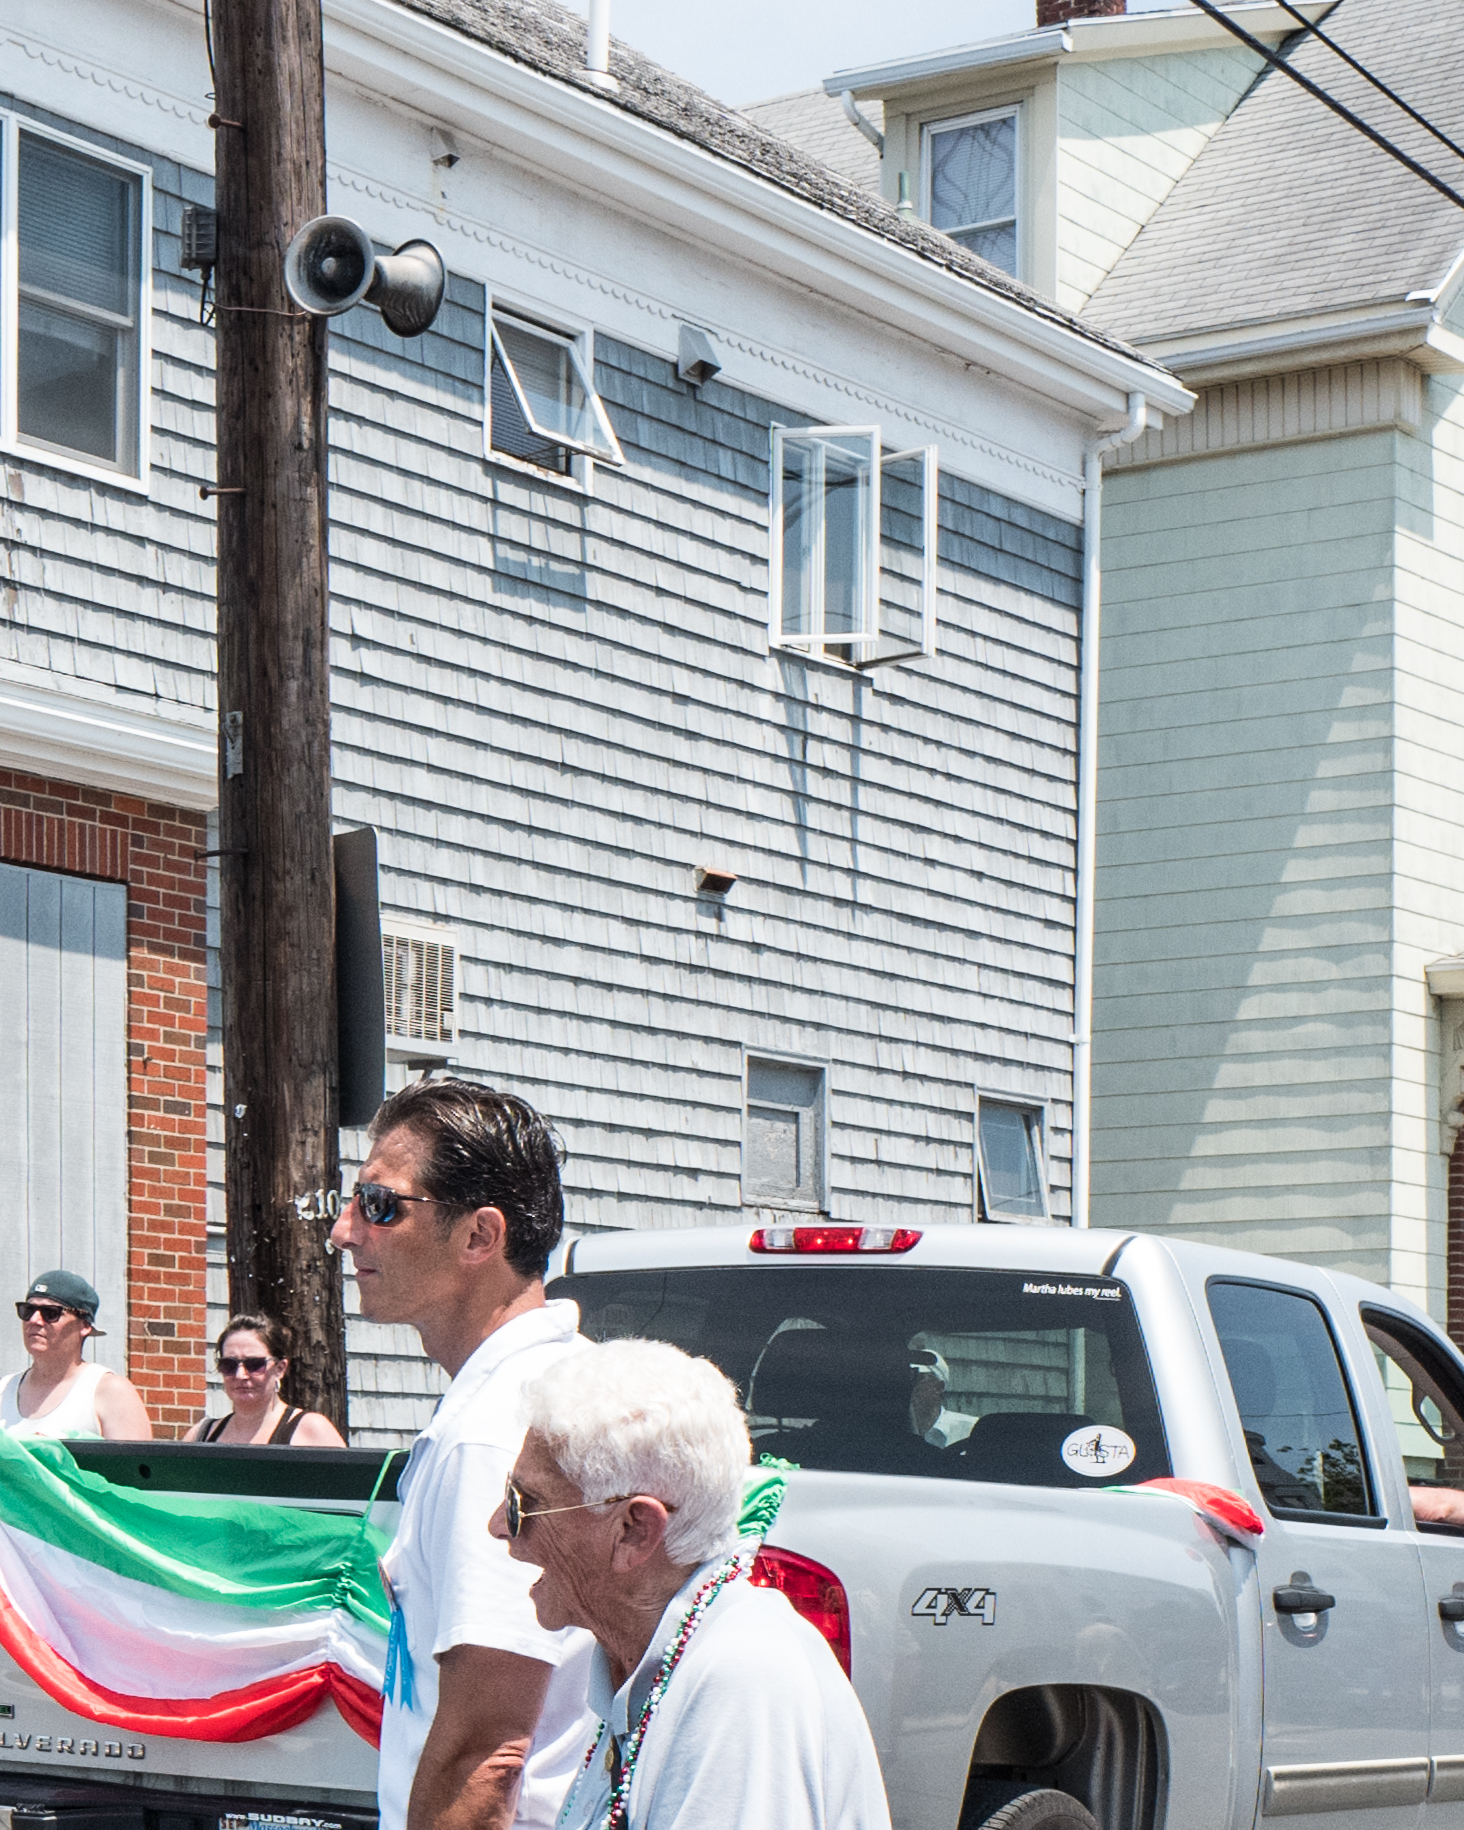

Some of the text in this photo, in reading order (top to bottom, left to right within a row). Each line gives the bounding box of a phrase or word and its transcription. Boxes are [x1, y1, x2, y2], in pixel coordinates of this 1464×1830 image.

[1023, 1283, 1057, 1294] Martha
[1058, 1284, 1083, 1295] lubes
[1084, 1288, 1101, 1298] my
